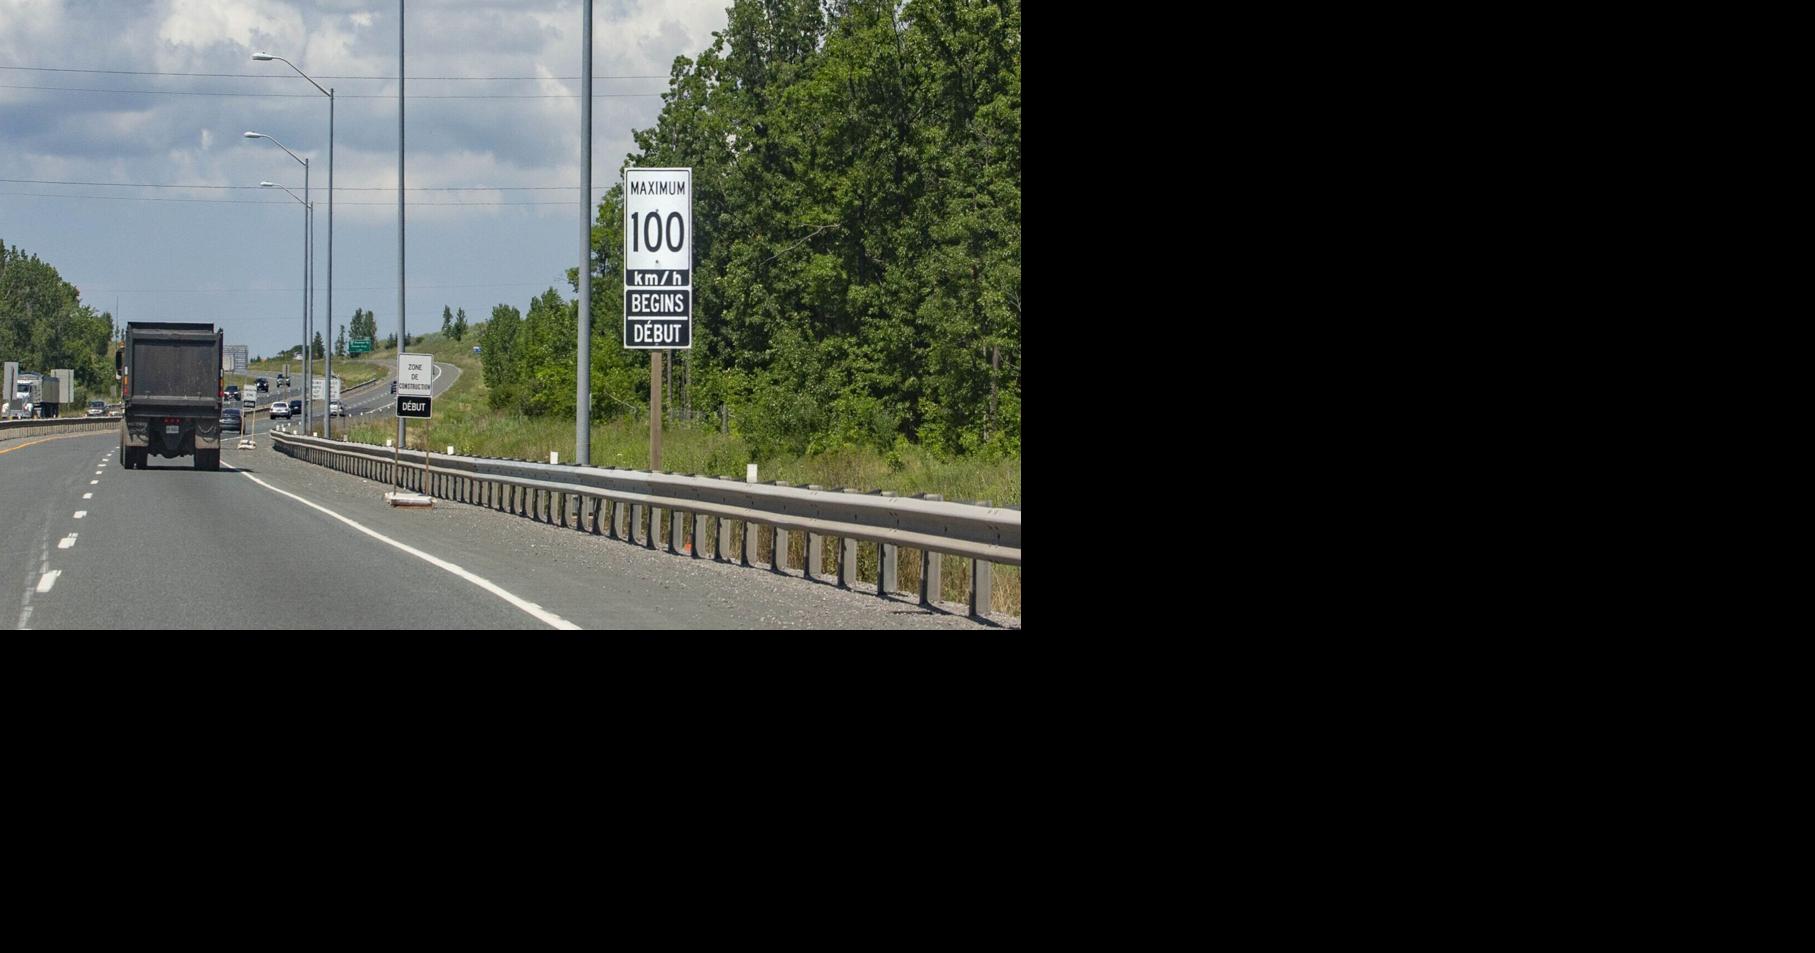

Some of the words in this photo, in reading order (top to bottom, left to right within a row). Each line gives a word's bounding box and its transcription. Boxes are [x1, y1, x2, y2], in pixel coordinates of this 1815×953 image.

[630, 181, 685, 195] MAXIMUM
[631, 211, 684, 252] 100
[634, 271, 682, 285] km/h
[631, 294, 684, 313] BEGINS
[634, 320, 682, 343] DÉBUT
[402, 400, 426, 411] DÉBUT
